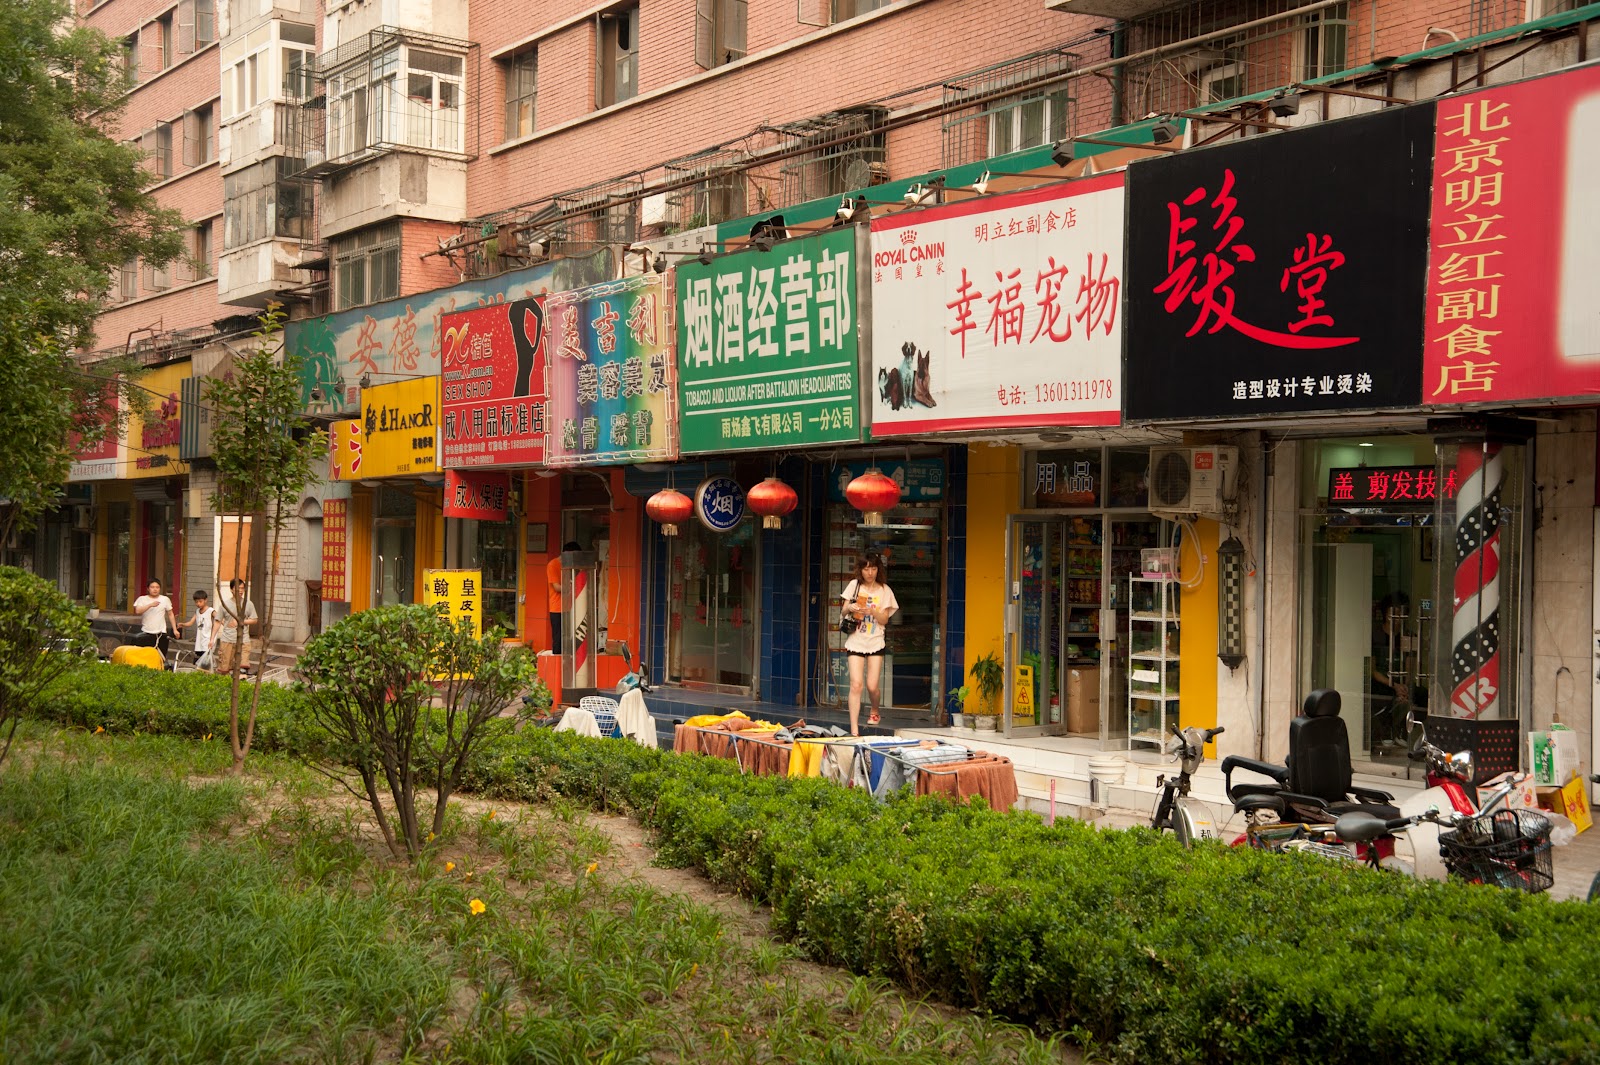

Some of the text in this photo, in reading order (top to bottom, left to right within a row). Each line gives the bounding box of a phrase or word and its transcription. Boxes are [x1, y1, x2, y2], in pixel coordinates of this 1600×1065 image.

[974, 207, 1077, 244] 明立红副食店
[874, 242, 945, 268] ROYAL CANIN
[1432, 100, 1512, 397] 北京明立红副食店
[874, 259, 945, 284] 法国皇家
[683, 248, 851, 368] 烟酒经营部
[946, 252, 1120, 360] 幸福宠物
[557, 293, 658, 361] 美吉利
[445, 380, 493, 401] SEX SHOP
[577, 353, 667, 405] 美容美发
[685, 372, 852, 407] TOBACCO AND LIQUOR AFTER BATTALION HEADQUARTERS
[1035, 378, 1112, 403] 13601311978
[1232, 372, 1373, 400] 造型设计专业烫染
[389, 403, 433, 430] HANOR
[445, 402, 544, 440] 成人用品标准店
[808, 406, 853, 431] 一分公司
[1032, 460, 1094, 496] 用品
[1332, 472, 1355, 500] 盖
[454, 481, 505, 511] 成人保健
[711, 490, 734, 516] 烟
[433, 578, 477, 597] 翰皇
